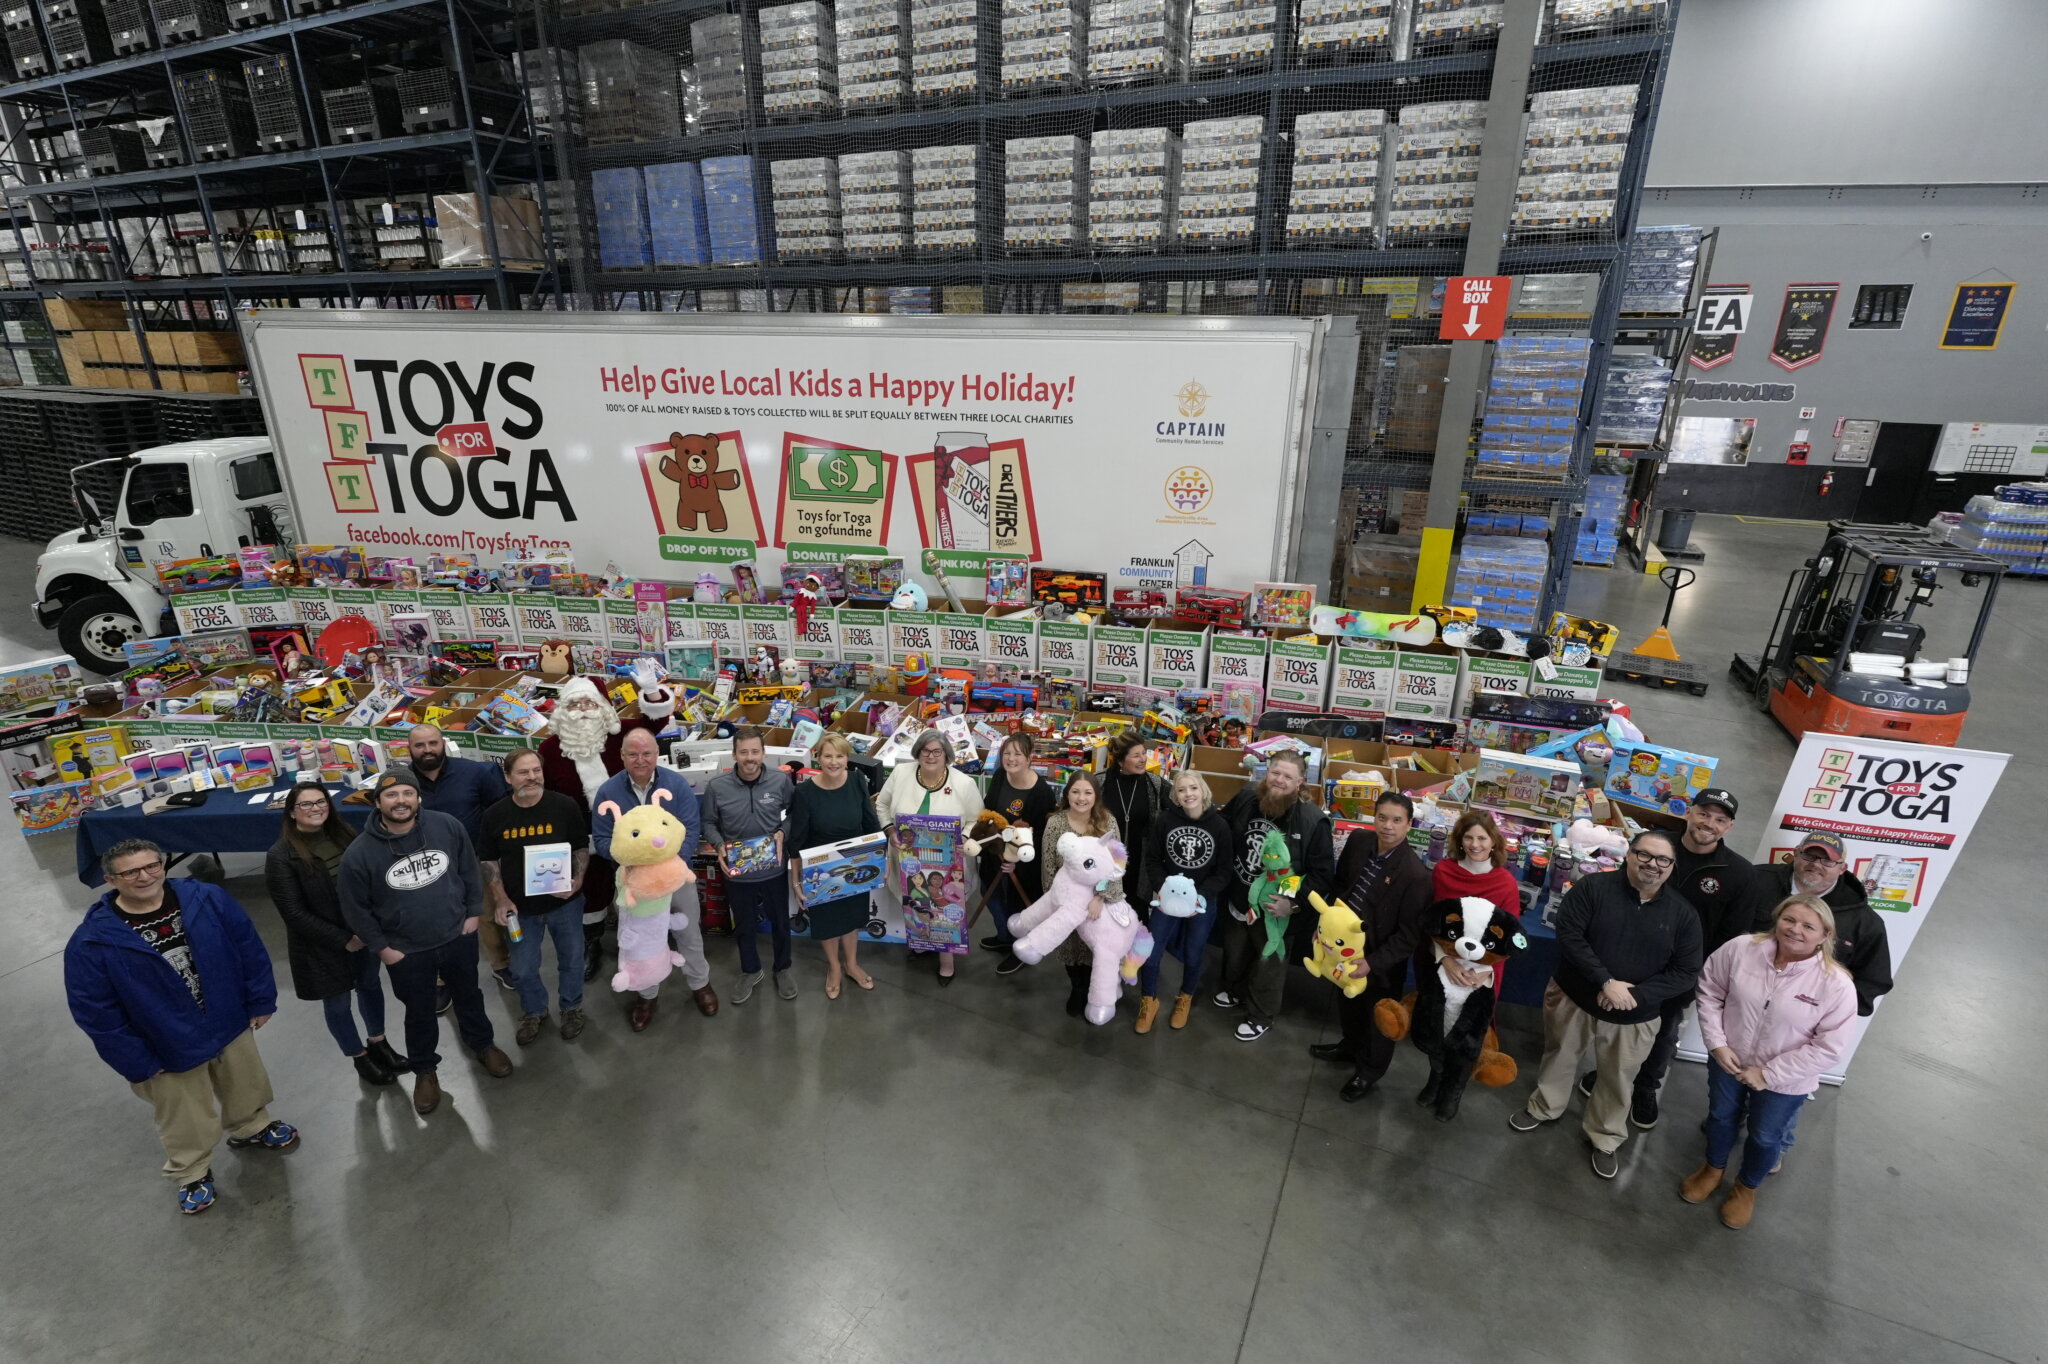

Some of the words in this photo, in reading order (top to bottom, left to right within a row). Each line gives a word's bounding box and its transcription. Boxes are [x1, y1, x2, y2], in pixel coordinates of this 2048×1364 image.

[1463, 280, 1492, 292] CALL
[1463, 292, 1490, 304] BOX
[600, 364, 656, 400] Help
[661, 367, 715, 395] Give
[720, 368, 781, 396] Local
[788, 368, 842, 397] Kids
[848, 378, 862, 397] a
[869, 372, 955, 408] Happy
[961, 372, 1075, 410] Holiday!
[354, 359, 543, 440] TOYS
[605, 404, 626, 413] 100%
[628, 404, 639, 413] OF
[641, 405, 656, 413] ALL
[658, 406, 690, 414] MONEY
[692, 406, 722, 415] RAISED
[733, 408, 756, 416] TOYS
[757, 408, 807, 417] COLLECTED
[809, 409, 830, 418] WILL
[832, 410, 843, 418] BE
[845, 410, 868, 419] SPLIT
[870, 411, 911, 421] EQUALLY
[914, 412, 957, 421] BETWEEN
[960, 413, 988, 422] THREE
[990, 414, 1021, 423] LOCAL
[1024, 415, 1073, 424] CHARITIES
[1157, 421, 1226, 437] CAPTAIN
[453, 432, 488, 449] FOR
[365, 442, 578, 522] TOGA
[995, 464, 1018, 538] DRUTHERS
[797, 509, 823, 523] Toys
[826, 510, 841, 522] for
[842, 512, 871, 526] Toga
[798, 525, 812, 534] on
[814, 523, 872, 538] gofundme
[666, 544, 696, 554] DROP
[698, 545, 718, 555] OFF
[720, 547, 749, 557] TOYS
[792, 551, 838, 562] DONATE
[960, 560, 979, 569] FOR
[1131, 557, 1175, 568] FRANKLIN
[1119, 567, 1174, 578] COMMUNITY
[191, 605, 226, 618] TOYS
[248, 606, 273, 616] TOYS
[300, 602, 326, 612] TOYS
[389, 604, 415, 613] TOYS
[479, 608, 505, 617] TOYS
[250, 615, 278, 623] TOGA
[303, 611, 331, 622] TOGA
[526, 608, 552, 619] TOYS
[193, 616, 232, 628] TOGA
[481, 617, 510, 628] TOGA
[528, 619, 556, 630] TOGA
[568, 616, 588, 624] TOYS
[615, 618, 636, 626] TOYS
[569, 623, 592, 632] TOGA
[706, 623, 727, 632] TOYS
[753, 623, 775, 632] TOYS
[849, 628, 871, 637] TOYS
[901, 627, 928, 638] TOYS
[707, 631, 730, 639] TOGA
[754, 632, 778, 640] TOGA
[950, 629, 976, 640] TOYS
[850, 637, 873, 645] TOGA
[901, 637, 932, 648] TOGA
[949, 640, 979, 651] TOGA
[999, 635, 1026, 647] TOYS
[1050, 641, 1072, 651] TOYS
[999, 646, 1028, 657] TOGA
[1050, 650, 1074, 660] TOGA
[1107, 644, 1136, 655] TOYS
[1164, 648, 1193, 660] TOYS
[1108, 655, 1138, 667] TOGA
[1162, 660, 1195, 672] TOGA
[1222, 657, 1247, 667] TOYS
[1286, 659, 1316, 672] TOYS
[1220, 666, 1248, 677] TOGA
[1349, 669, 1374, 680] TOYS
[1486, 666, 1516, 674] Unwrapped
[1283, 672, 1318, 685] TOGA
[1346, 679, 1375, 689] TOGA
[1409, 675, 1436, 686] TOYS
[1483, 677, 1517, 690] TOYS
[1406, 685, 1436, 696] TOGA
[1860, 690, 1948, 711] TOYOTA
[18, 728, 52, 741] HOCKEY
[52, 721, 79, 733] TABLE
[1857, 754, 1965, 792] TOYS
[1840, 784, 1951, 823] TOGA
[928, 821, 956, 829] GIANT
[1791, 816, 1810, 826] Help
[1811, 820, 1831, 828] Give
[1832, 822, 1853, 832] Local
[1855, 825, 1872, 834] Kids
[1880, 828, 1908, 838] Happy
[1909, 832, 1946, 842] Holiday!
[1810, 834, 1840, 848] NASA
[393, 854, 440, 877] DRUTHERS
